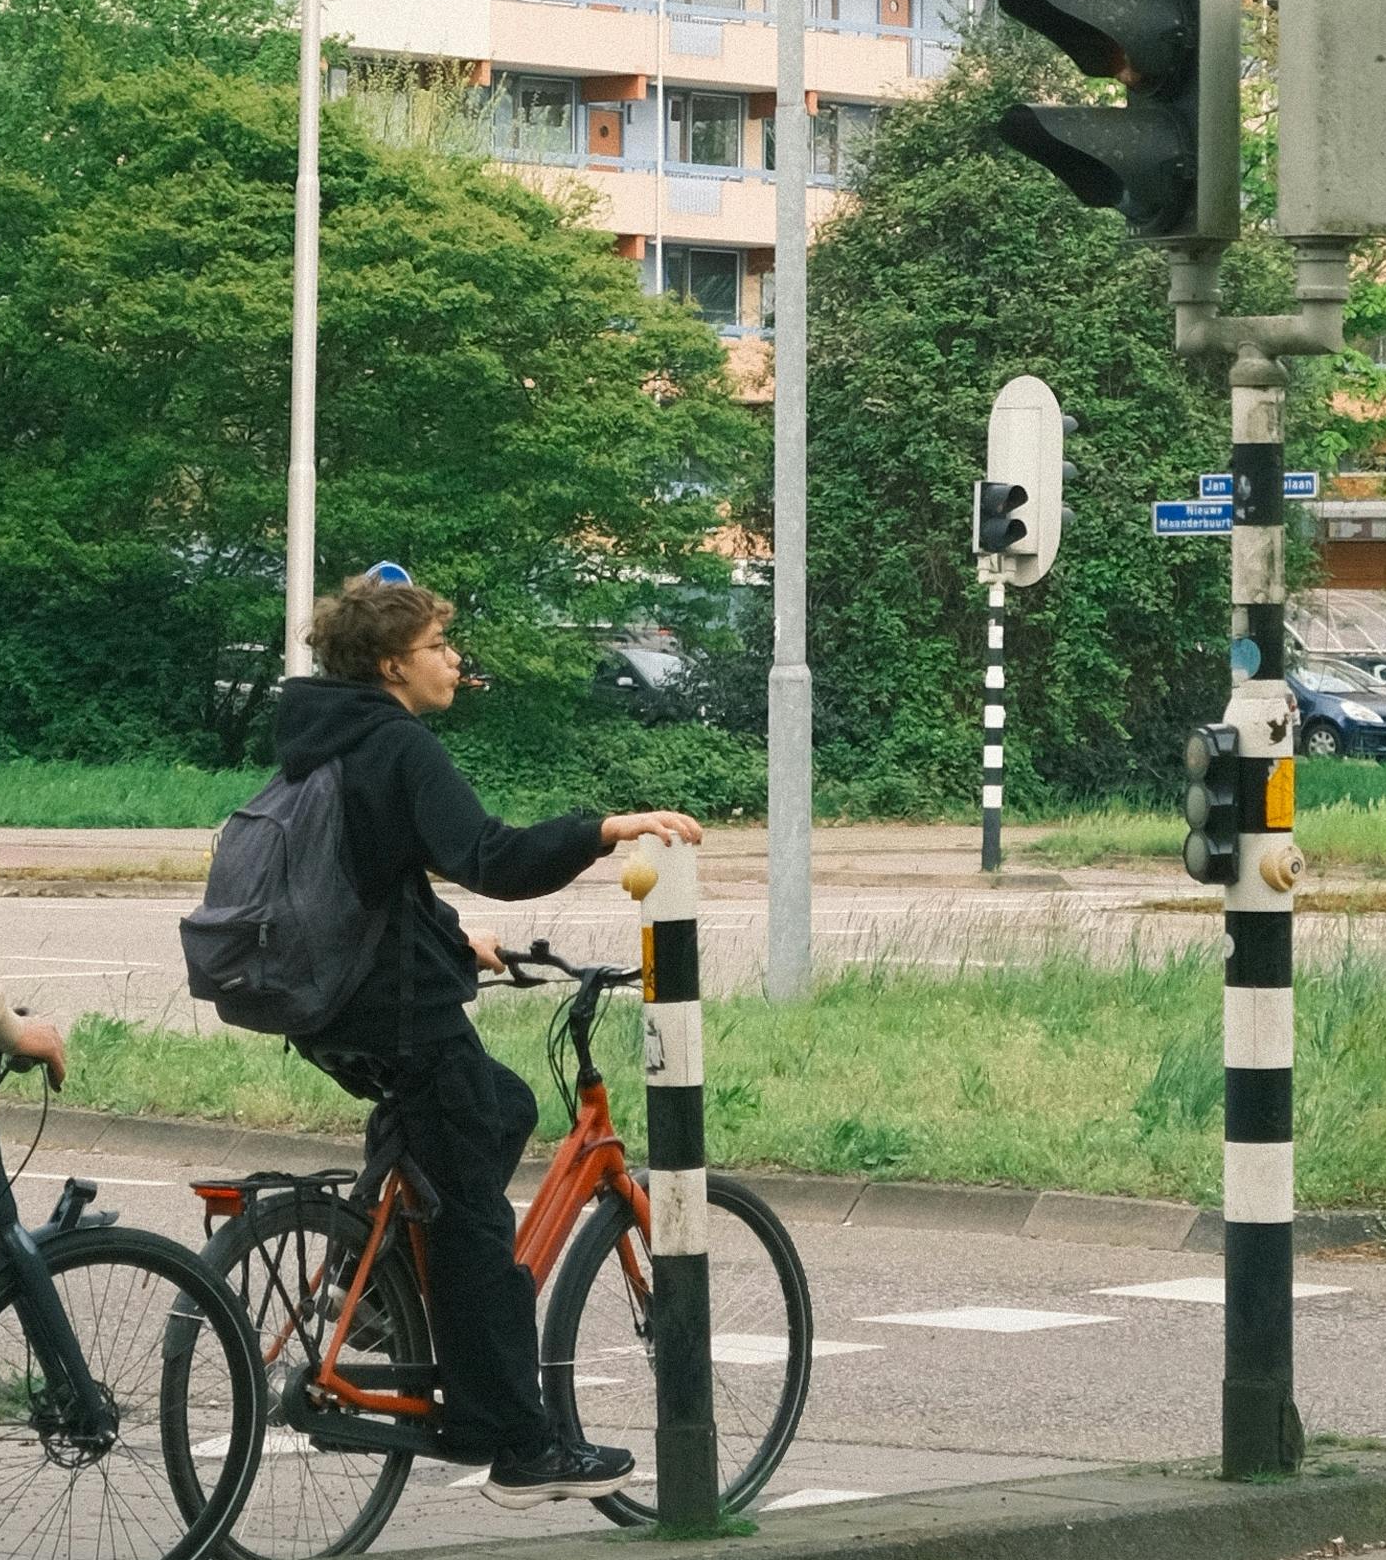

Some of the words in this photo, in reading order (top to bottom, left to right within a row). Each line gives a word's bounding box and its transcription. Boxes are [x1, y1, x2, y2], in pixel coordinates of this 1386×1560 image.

[1204, 480, 1226, 492] Jan
[1185, 506, 1223, 516] Nieuwe
[1159, 519, 1233, 529] Maanderbuurt
